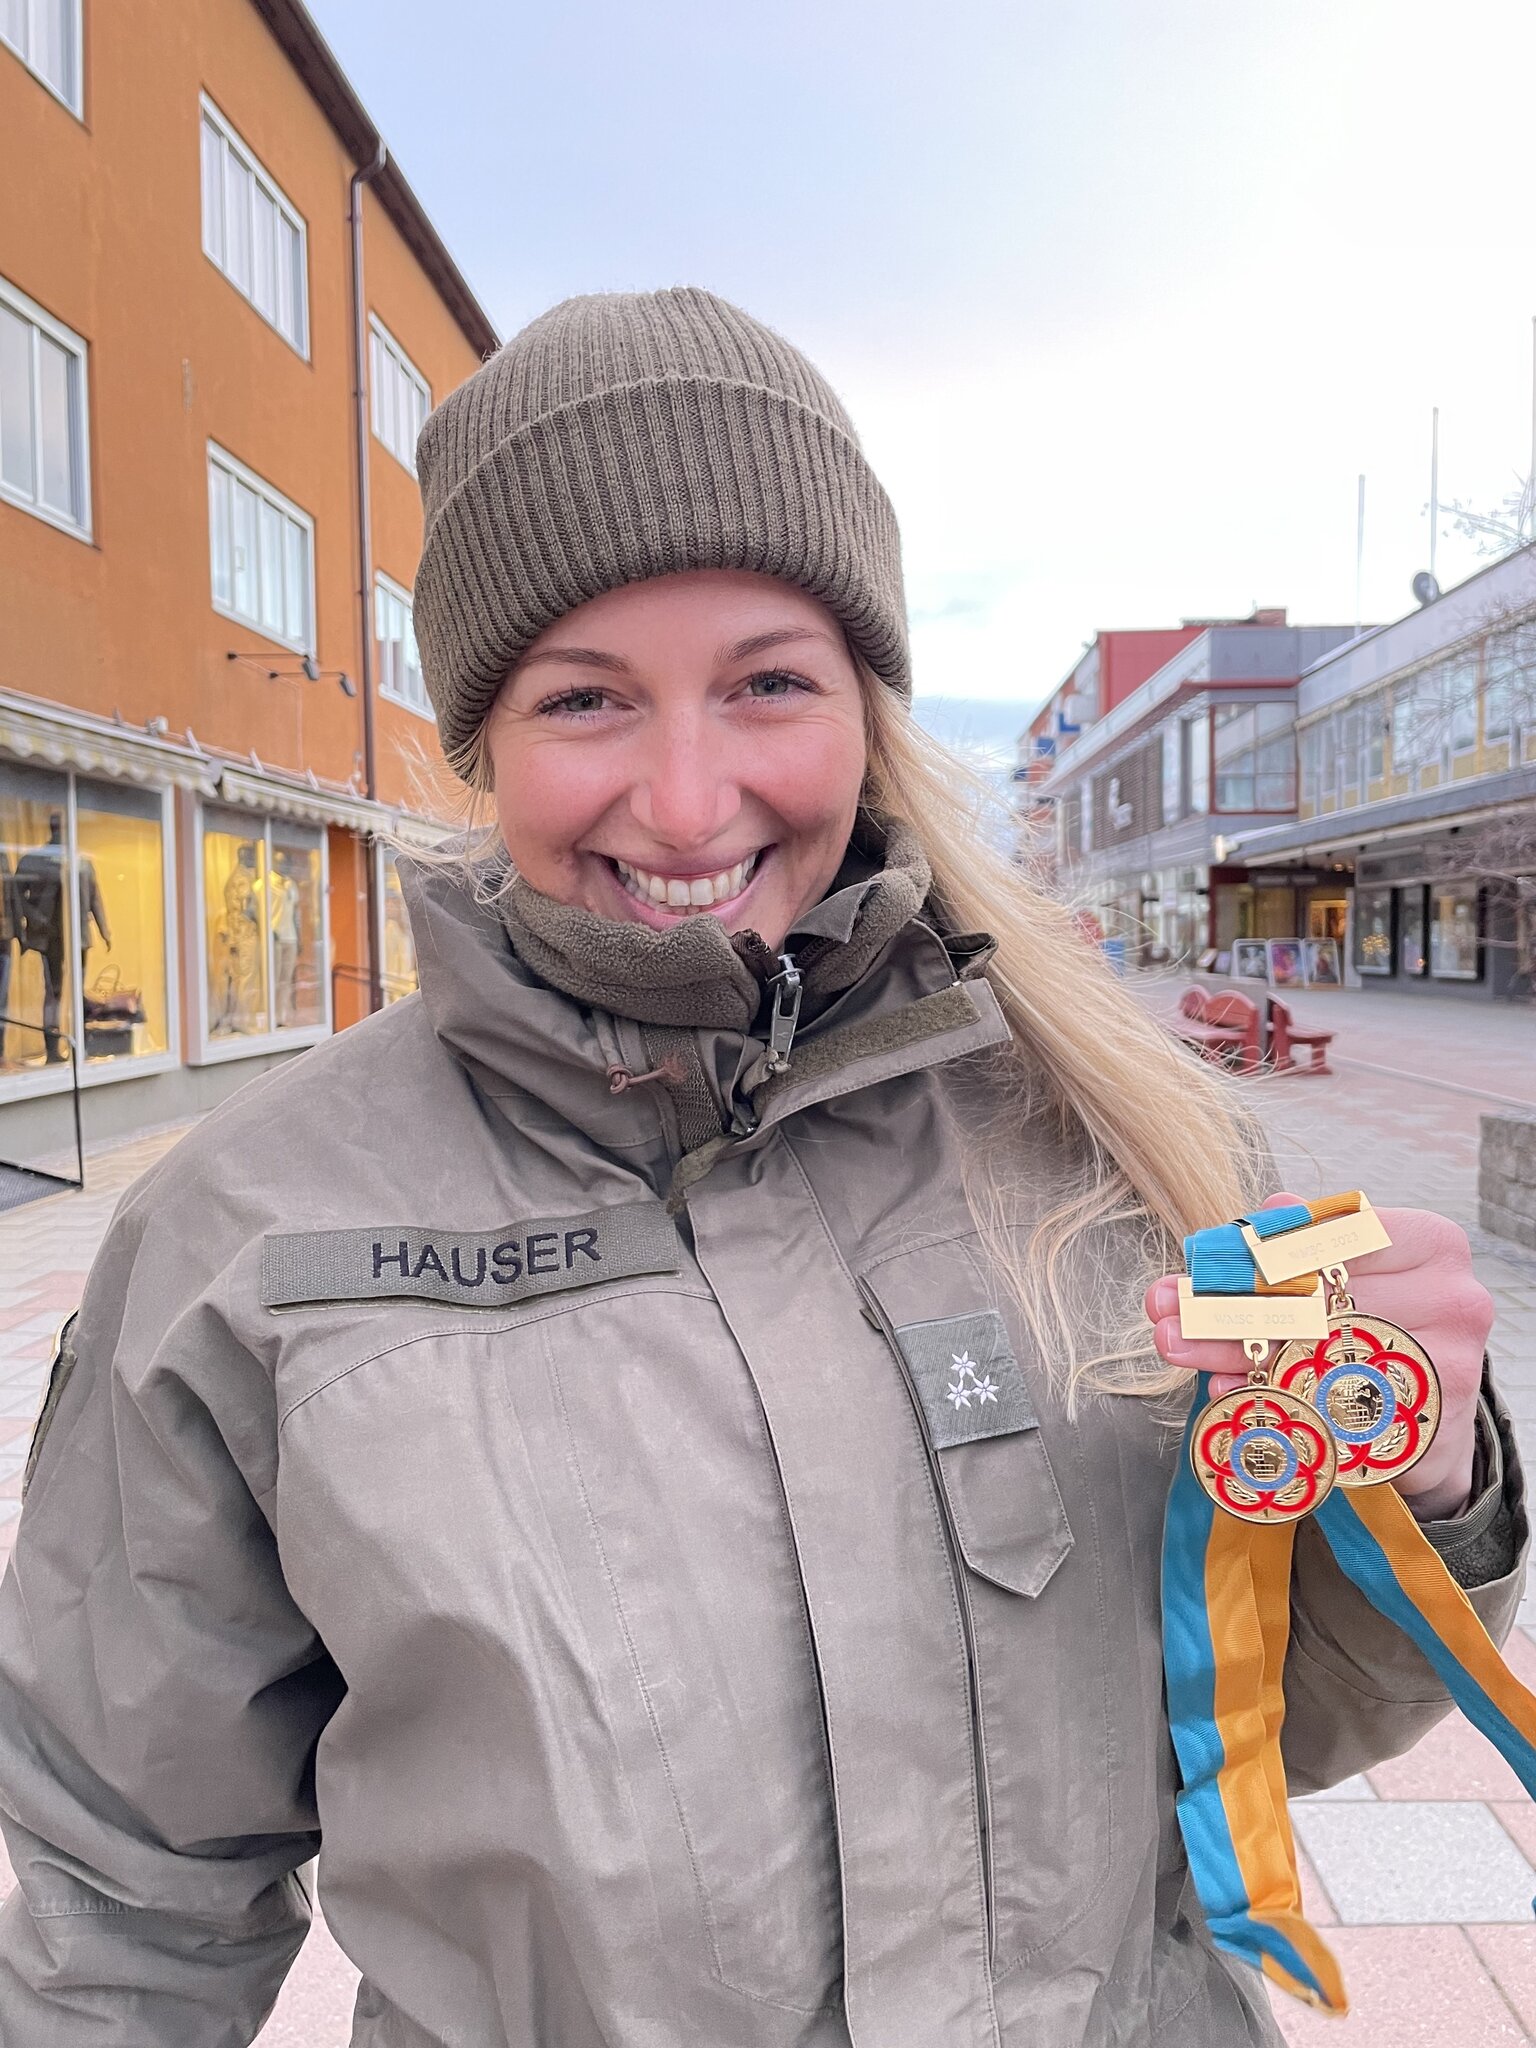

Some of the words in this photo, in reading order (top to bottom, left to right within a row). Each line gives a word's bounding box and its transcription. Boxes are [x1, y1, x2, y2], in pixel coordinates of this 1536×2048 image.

[1330, 1231, 1360, 1248] 2023
[372, 1227, 602, 1287] HAUSER
[1263, 1313, 1296, 1325] 2023
